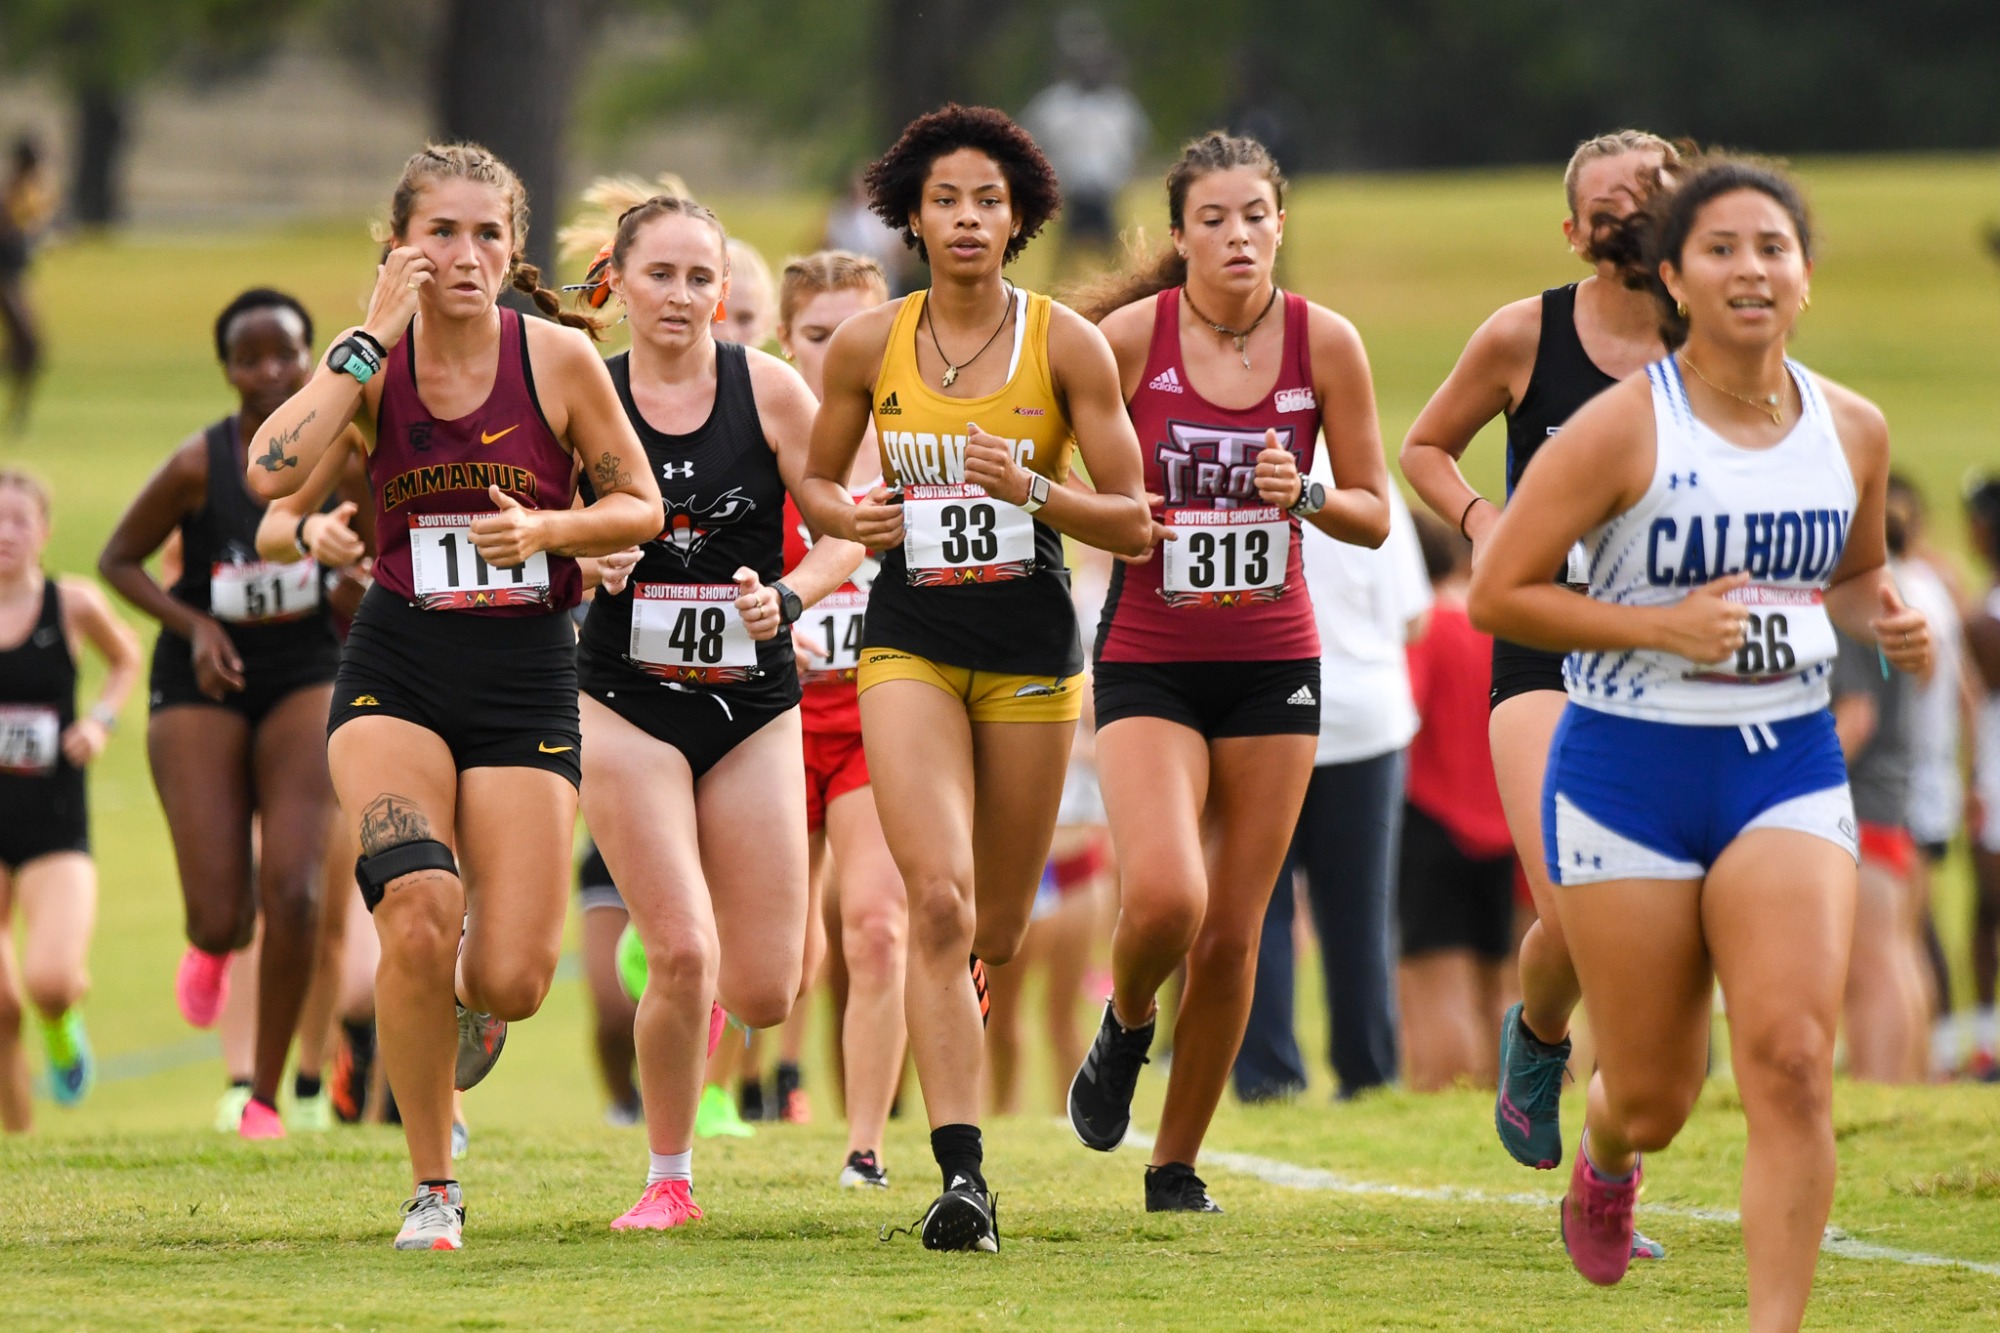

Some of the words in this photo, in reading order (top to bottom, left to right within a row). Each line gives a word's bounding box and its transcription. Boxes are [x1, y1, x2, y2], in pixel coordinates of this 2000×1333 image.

[1149, 381, 1183, 394] adidas
[879, 405, 902, 415] adidas
[1020, 408, 1045, 416] SWAC
[883, 431, 1035, 485] HORNS
[1156, 441, 1303, 507] TRO
[913, 483, 963, 498] SOUTHERN
[417, 514, 471, 527] SOUTHERN
[1174, 510, 1227, 525] SOUTHERN
[1229, 508, 1280, 524] SHOWCASE
[941, 503, 998, 564] 33
[1189, 529, 1269, 588] 313
[246, 577, 282, 614] 51
[643, 585, 697, 599] SOUTHERN
[699, 586, 740, 600] SHOWCA
[1722, 586, 1759, 604] HERN
[668, 607, 725, 664] 48
[819, 613, 864, 665] 14
[1736, 613, 1795, 674] 66
[1287, 697, 1316, 706] adidas
